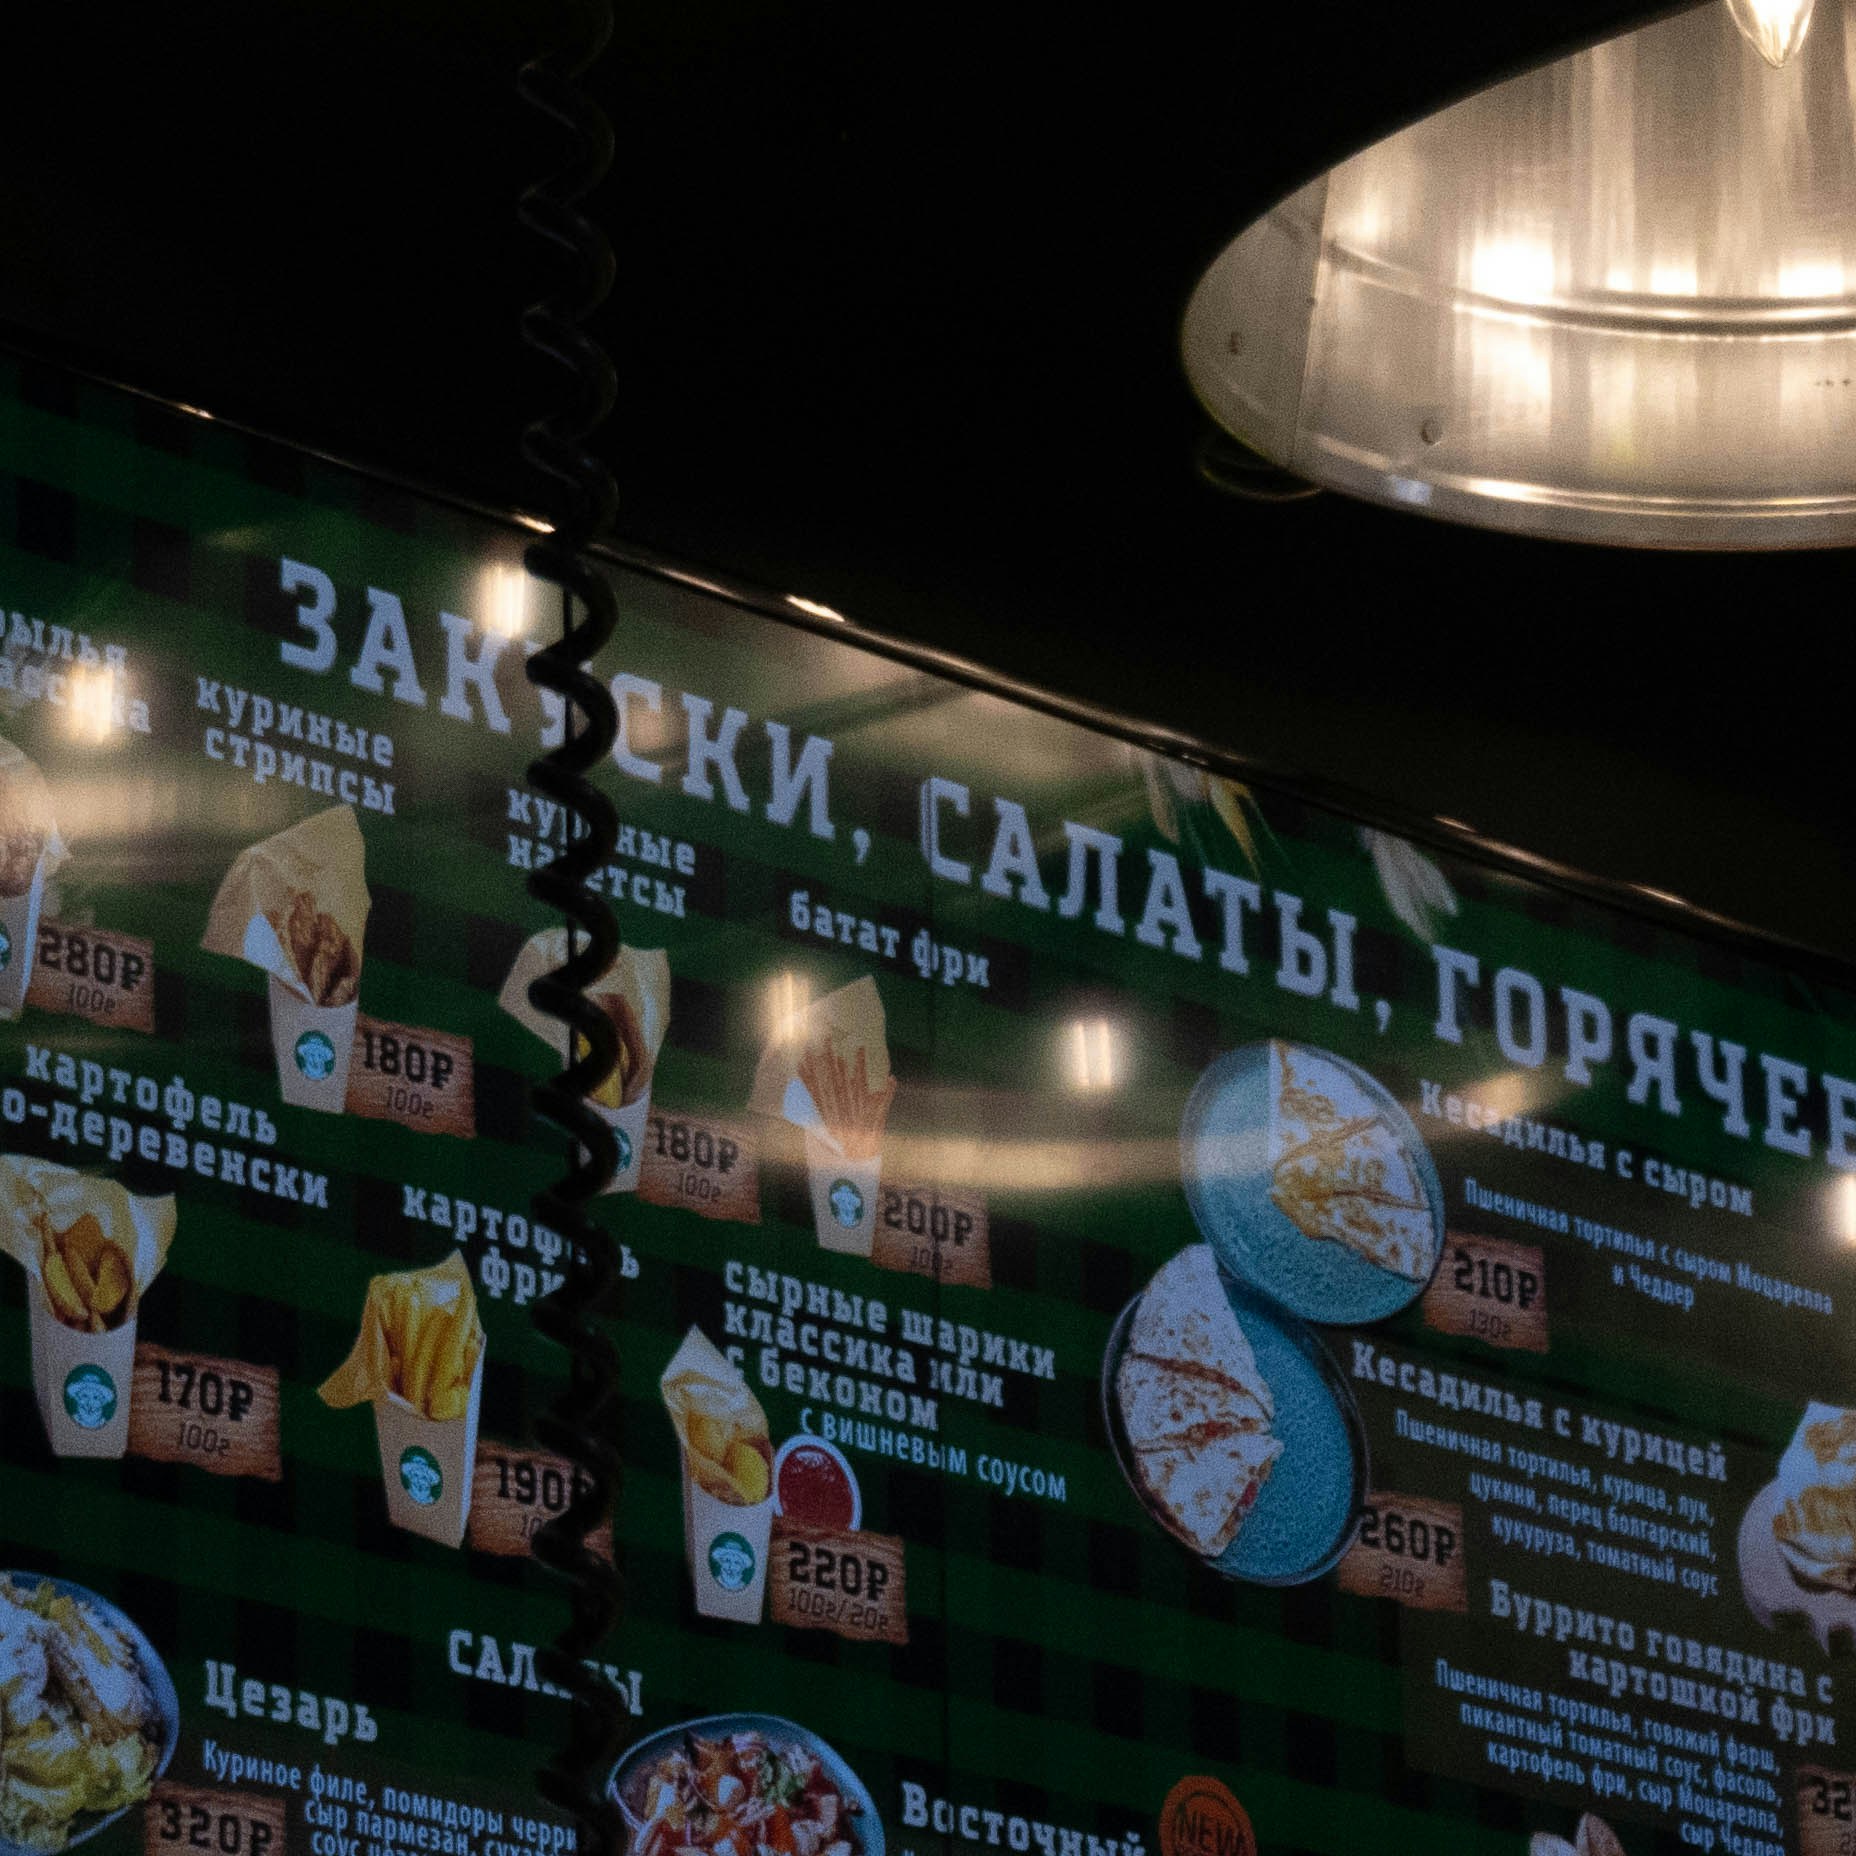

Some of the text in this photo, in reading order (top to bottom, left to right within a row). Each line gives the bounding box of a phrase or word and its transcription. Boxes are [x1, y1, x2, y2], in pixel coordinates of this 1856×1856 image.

[198, 675, 394, 768] куриные
[204, 726, 395, 815] стрипсы
[507, 788, 696, 876] курные
[507, 834, 686, 919] наетсы
[789, 890, 991, 989] батат фри
[919, 776, 1392, 1034] САЛАТЫ,
[25, 1044, 279, 1146] картофель
[1, 1087, 330, 1209] о-деревенски
[1420, 1080, 1755, 1217] Кесадилья с сыром
[401, 1183, 640, 1280] картофь
[1464, 1176, 1832, 1315] Пшеничная тортилья с сыром Моцарелла
[723, 1259, 1057, 1381] сырные шарики
[1612, 1263, 1694, 1312] и Чеддер
[723, 1300, 1006, 1408] классика или
[725, 1344, 939, 1432] с беконом
[800, 1407, 1067, 1503] с вишневым соусом
[1353, 1338, 1728, 1483] Кесадилья с курицей
[1395, 1408, 1715, 1528] Пшеничная тортилья, курица, лук,
[1469, 1472, 1717, 1564] цукини, перец болгарский,
[1491, 1513, 1720, 1599] кукуруза, томатный соус
[448, 1628, 644, 1717] САЛЫ
[1488, 1578, 1833, 1705] Буррито говядина с
[204, 1657, 378, 1745] Цезарь
[1435, 1656, 1782, 1777] Пшеничная тортилья, говяжий фарш,
[1568, 1648, 1837, 1746] картошкой фри
[202, 1738, 302, 1791] Куриное
[309, 1761, 376, 1812] филе,
[382, 1785, 504, 1838] помидоры
[1459, 1701, 1784, 1809] пикантный томатный соус, фасоль,
[1590, 1760, 1634, 1802] фри,
[1638, 1777, 1673, 1814] сыр
[1677, 1782, 1785, 1840] Моцарелла,
[304, 1799, 348, 1833] сыр
[1680, 1821, 1715, 1854] сыр
